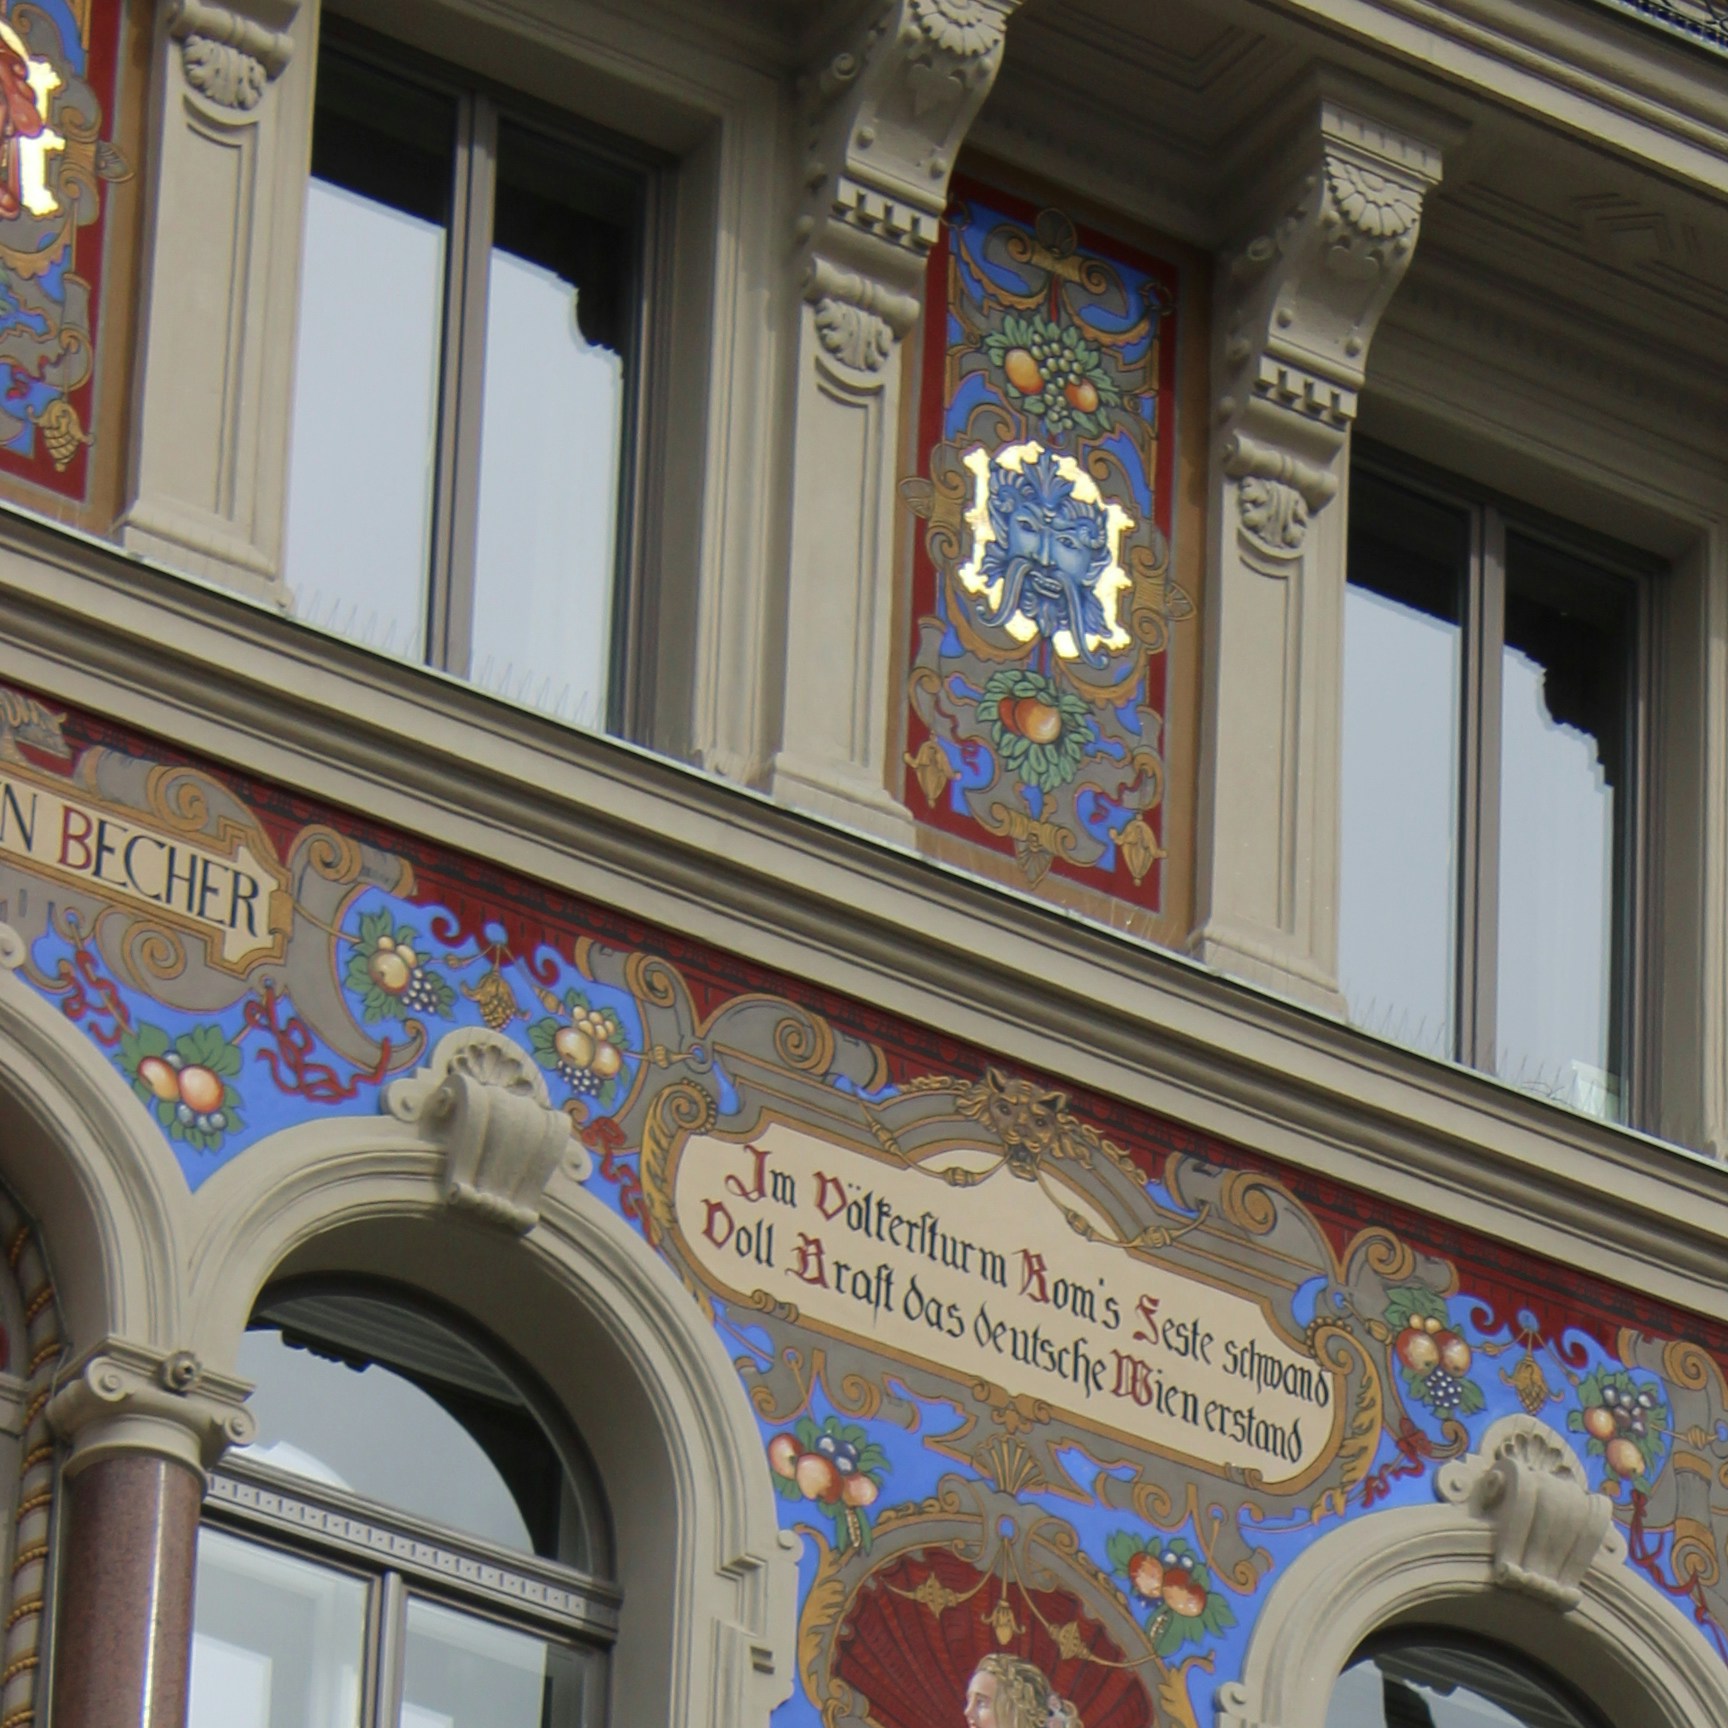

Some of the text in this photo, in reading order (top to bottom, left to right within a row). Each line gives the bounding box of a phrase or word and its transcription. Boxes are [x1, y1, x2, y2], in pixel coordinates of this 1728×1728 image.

[58, 804, 261, 937] BECHER
[700, 1198, 775, 1268] Voll
[903, 1273, 965, 1338] das
[973, 1301, 1107, 1399] deutsche
[1109, 1348, 1199, 1427] Wien
[1203, 1399, 1303, 1464] erstand
[724, 1143, 797, 1208] Im
[1222, 1339, 1330, 1408] schwand
